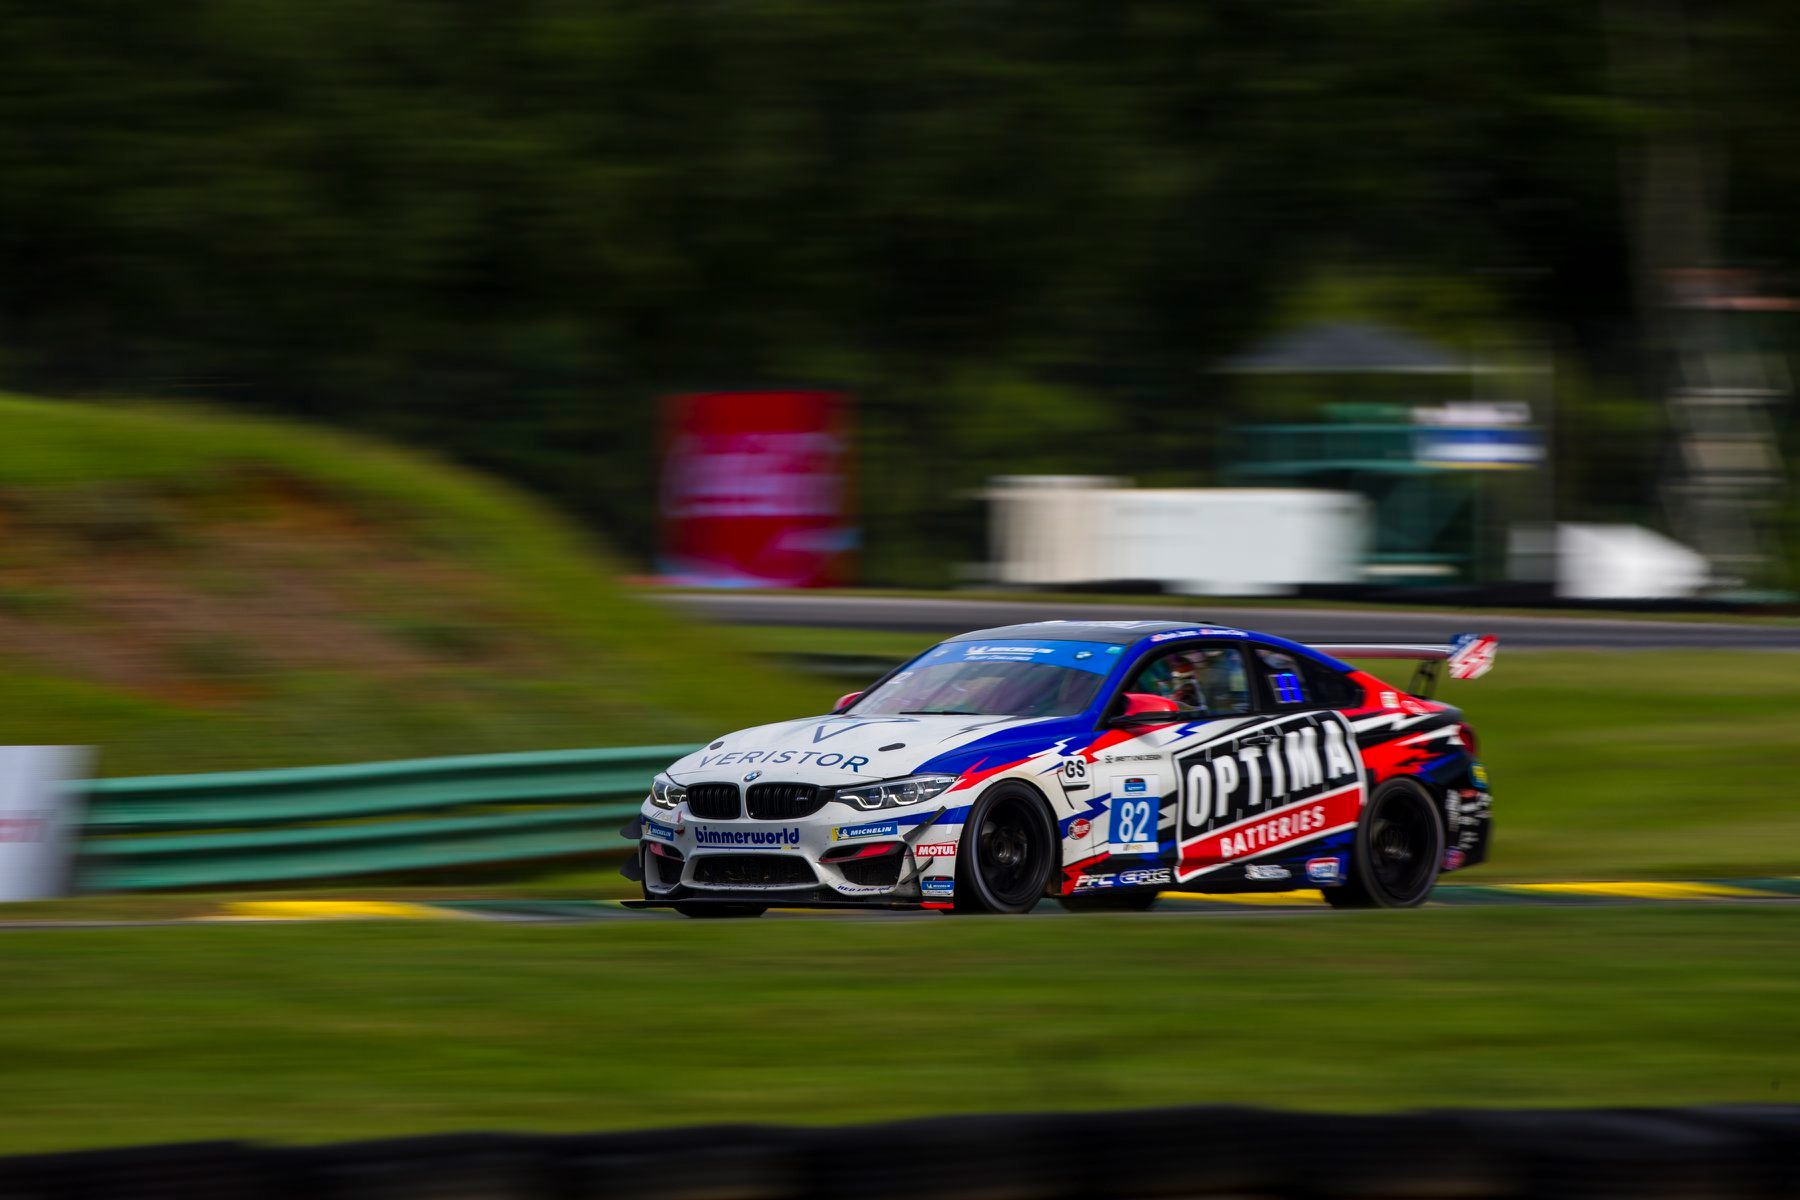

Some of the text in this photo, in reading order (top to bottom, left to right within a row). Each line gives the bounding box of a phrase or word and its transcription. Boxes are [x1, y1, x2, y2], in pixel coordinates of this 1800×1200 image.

[699, 750, 869, 773] VERISTOR
[1065, 760, 1086, 778] GS
[1187, 720, 1355, 827] OPTIMA
[850, 826, 892, 836] MICHELIN
[1118, 801, 1150, 843] 82
[695, 826, 800, 844] bimmerworld
[1220, 806, 1325, 858] BATTERIES
[917, 845, 955, 855] MOTUL
[1075, 873, 1116, 887] PFC
